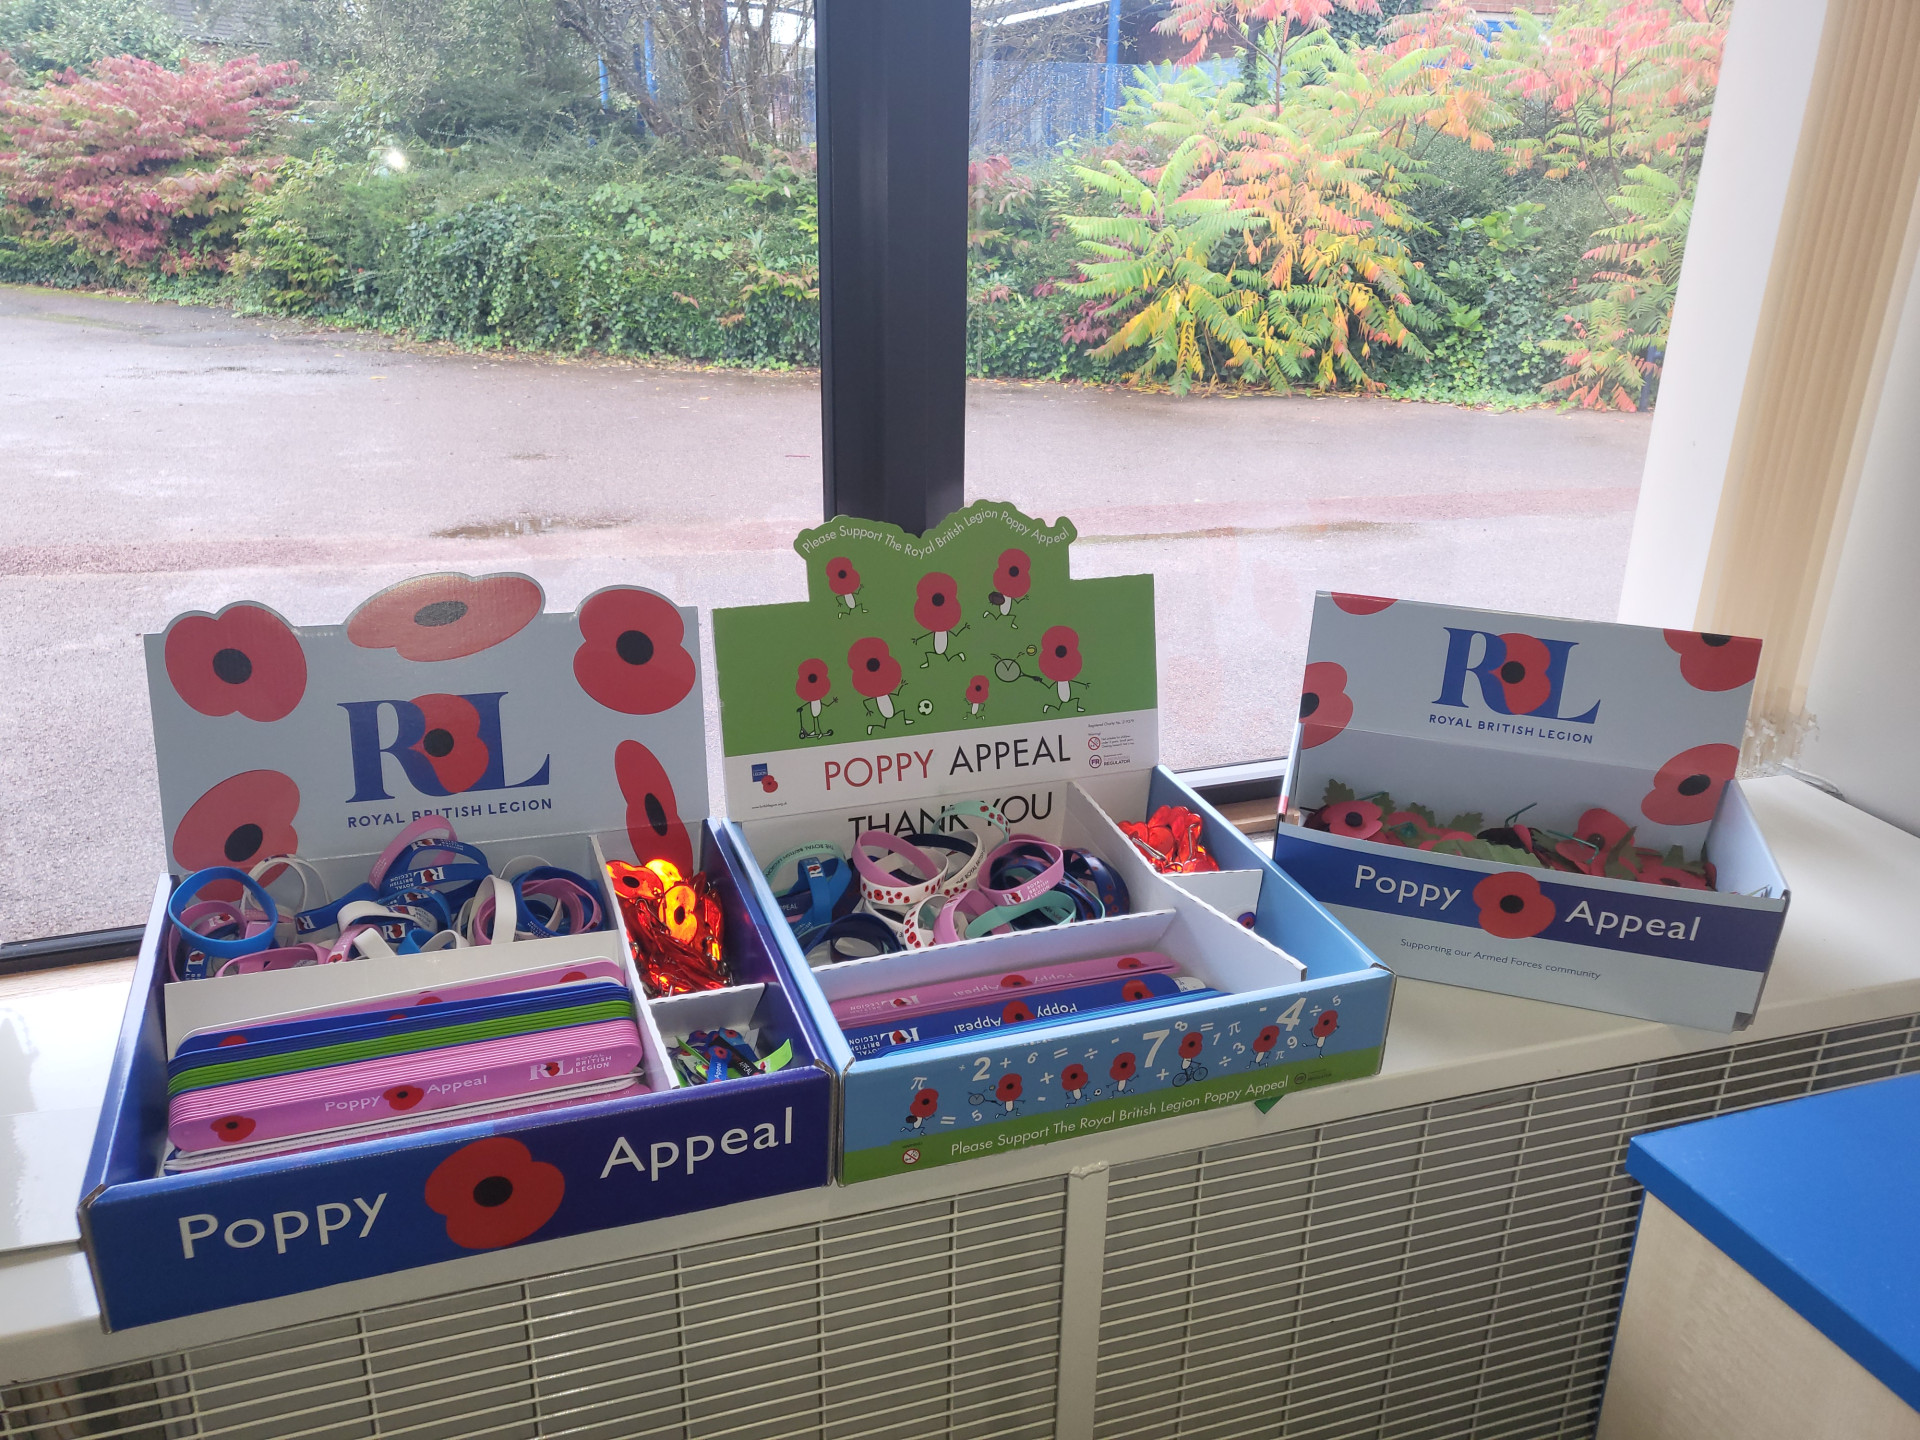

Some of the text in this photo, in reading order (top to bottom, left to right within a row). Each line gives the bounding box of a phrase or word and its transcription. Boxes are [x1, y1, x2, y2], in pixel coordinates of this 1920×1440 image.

[802, 508, 1070, 560] Please Support The Royal British Legion Poppy Appeal
[1429, 714, 1593, 744] ROYAL BRITISH LEGION
[824, 734, 1071, 791] POPPY APPEAL
[348, 812, 405, 828] ROYAL
[488, 798, 552, 815] LEGION
[847, 804, 969, 838] THANK
[1354, 864, 1702, 941] Poppy Appeal
[1401, 938, 1601, 981] Supporting our Armed Forces community
[954, 1003, 1078, 1034] Poppy Appeal
[1276, 997, 1307, 1032] 4
[849, 1034, 879, 1045] LEGION
[1142, 1029, 1170, 1068] 7
[576, 1056, 612, 1067] BRITISH
[576, 1062, 610, 1073] LEGION
[972, 1057, 992, 1082] 2
[324, 1075, 488, 1112] Poppy Appeal
[951, 1141, 993, 1156] Please
[997, 1126, 1050, 1146] Support
[1053, 1122, 1076, 1134] The
[1080, 1111, 1115, 1129] Royal
[1119, 1102, 1156, 1121] British
[1161, 1096, 1200, 1114] Legion
[1205, 1088, 1242, 1104] Poppy
[1245, 1075, 1289, 1096] Appeal
[178, 1107, 794, 1260] Poppy Appeal
